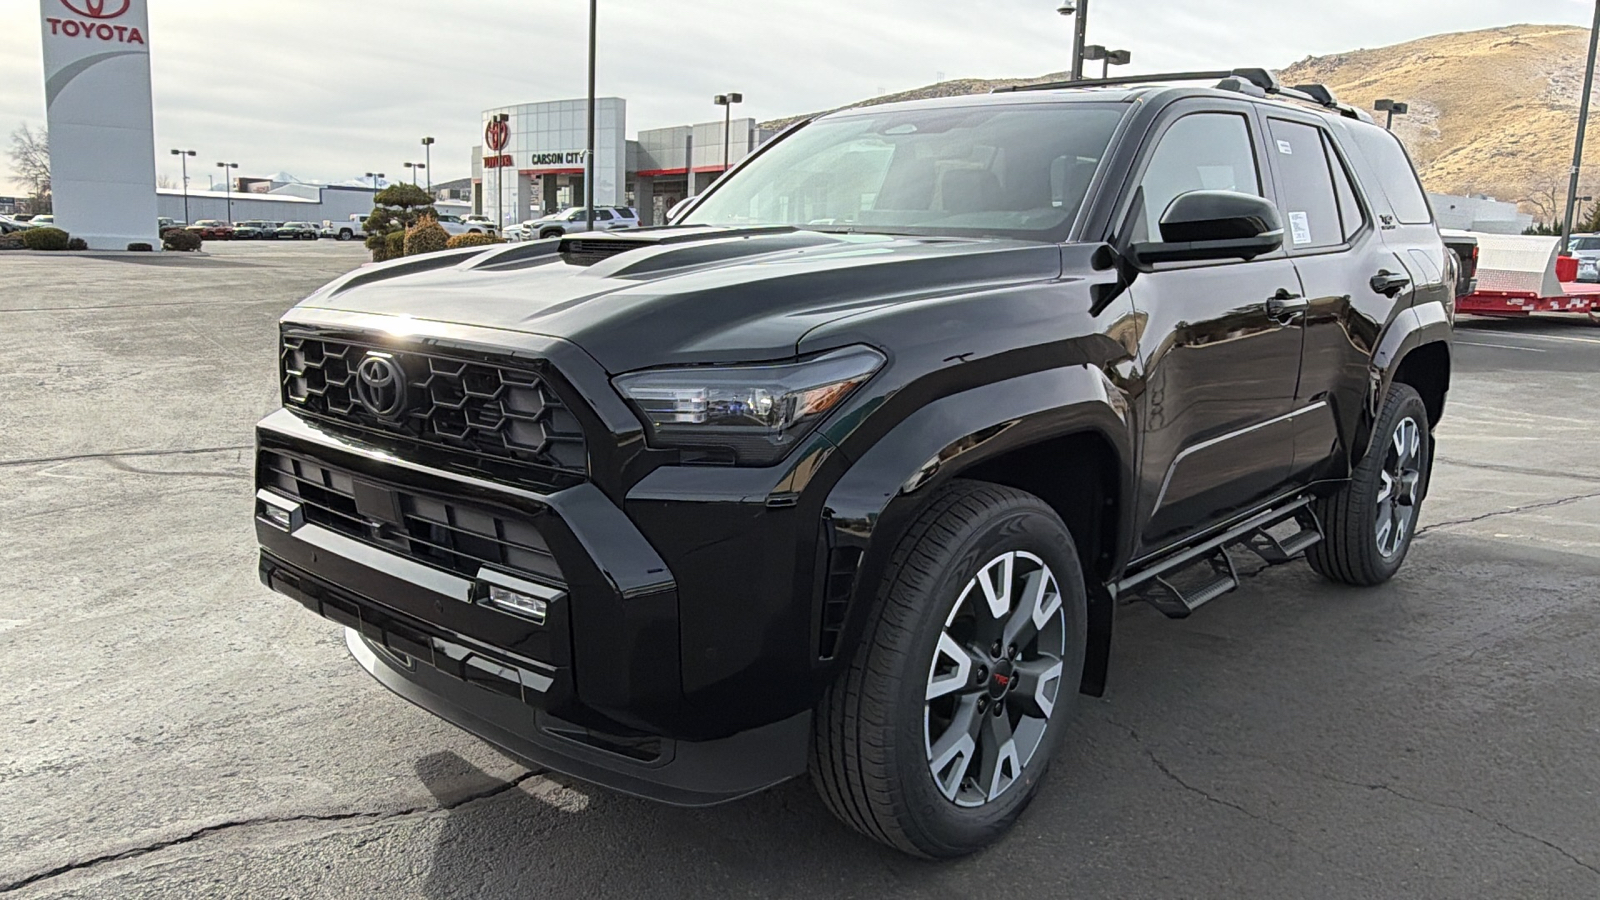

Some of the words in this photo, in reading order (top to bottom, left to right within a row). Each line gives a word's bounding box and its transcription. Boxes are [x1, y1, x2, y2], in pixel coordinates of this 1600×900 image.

[46, 18, 144, 44] TOYOTA
[532, 153, 563, 165] CARSON
[566, 151, 584, 164] CITY
